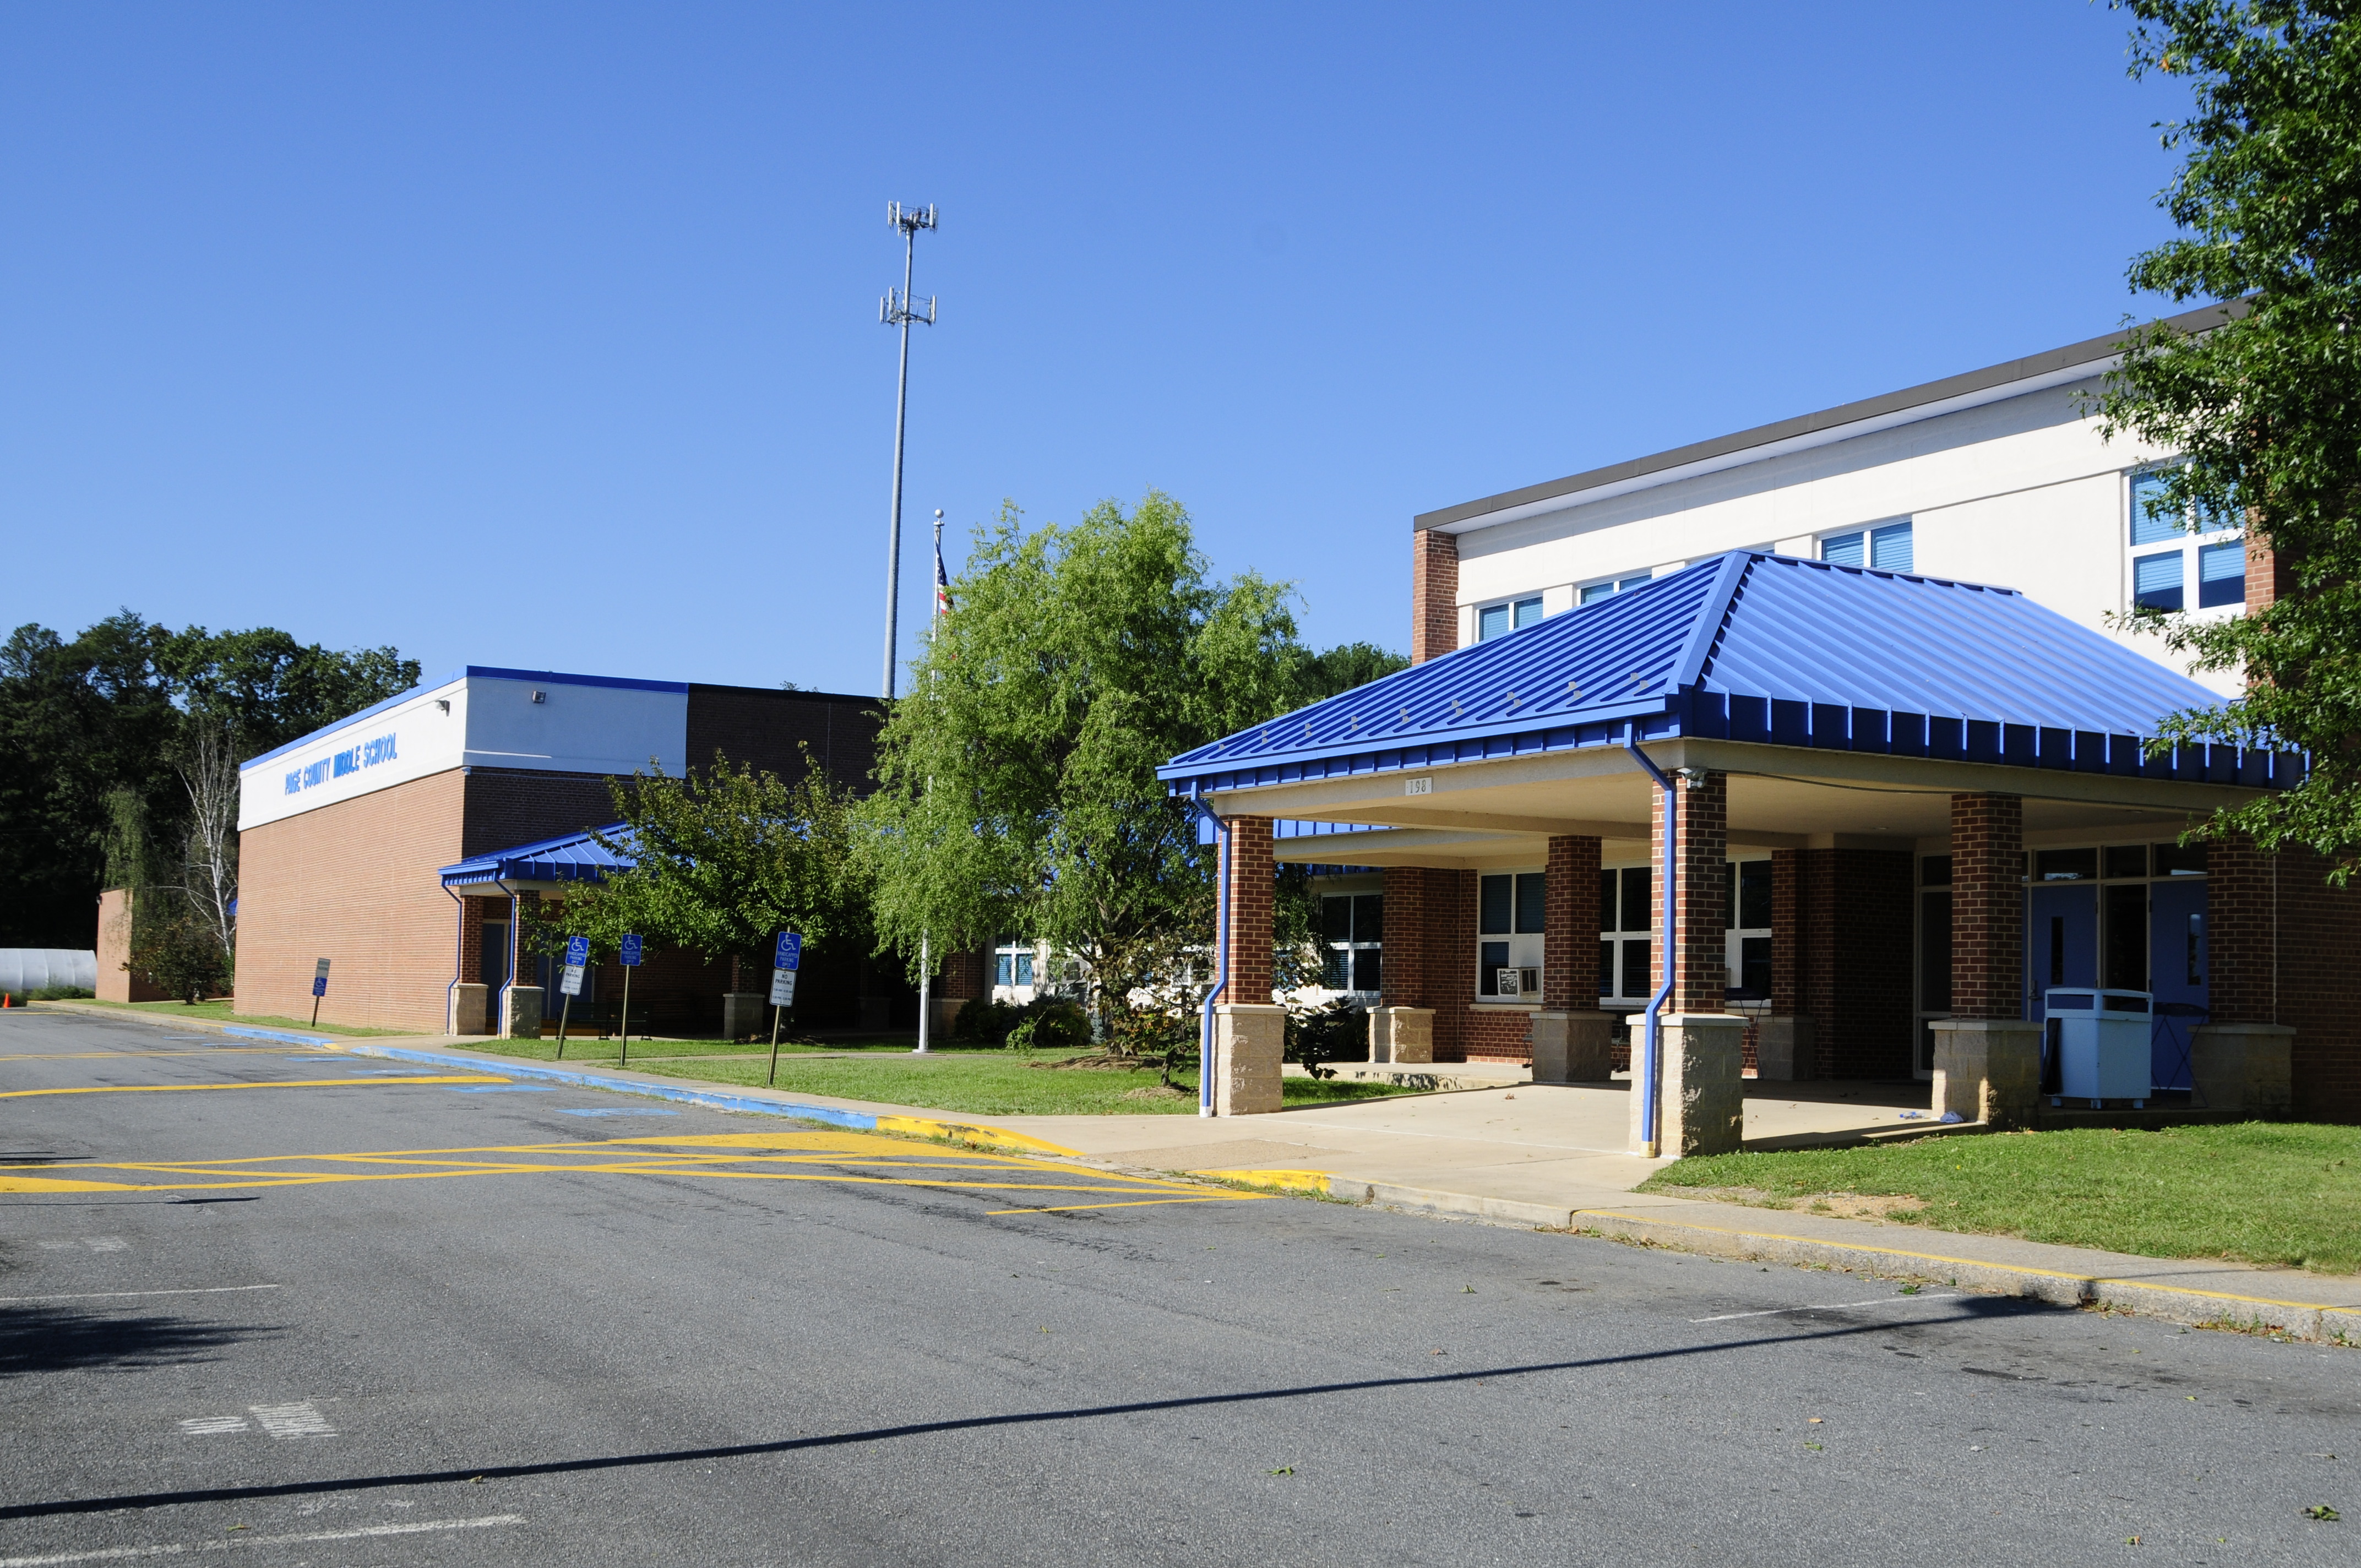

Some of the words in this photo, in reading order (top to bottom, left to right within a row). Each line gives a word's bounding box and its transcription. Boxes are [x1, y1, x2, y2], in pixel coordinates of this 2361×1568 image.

[285, 768, 301, 796] PAGE
[303, 757, 331, 790] COUNTY
[333, 745, 361, 778] MIDDLE
[363, 732, 398, 769] SCHOOL
[1410, 780, 1427, 794] 198
